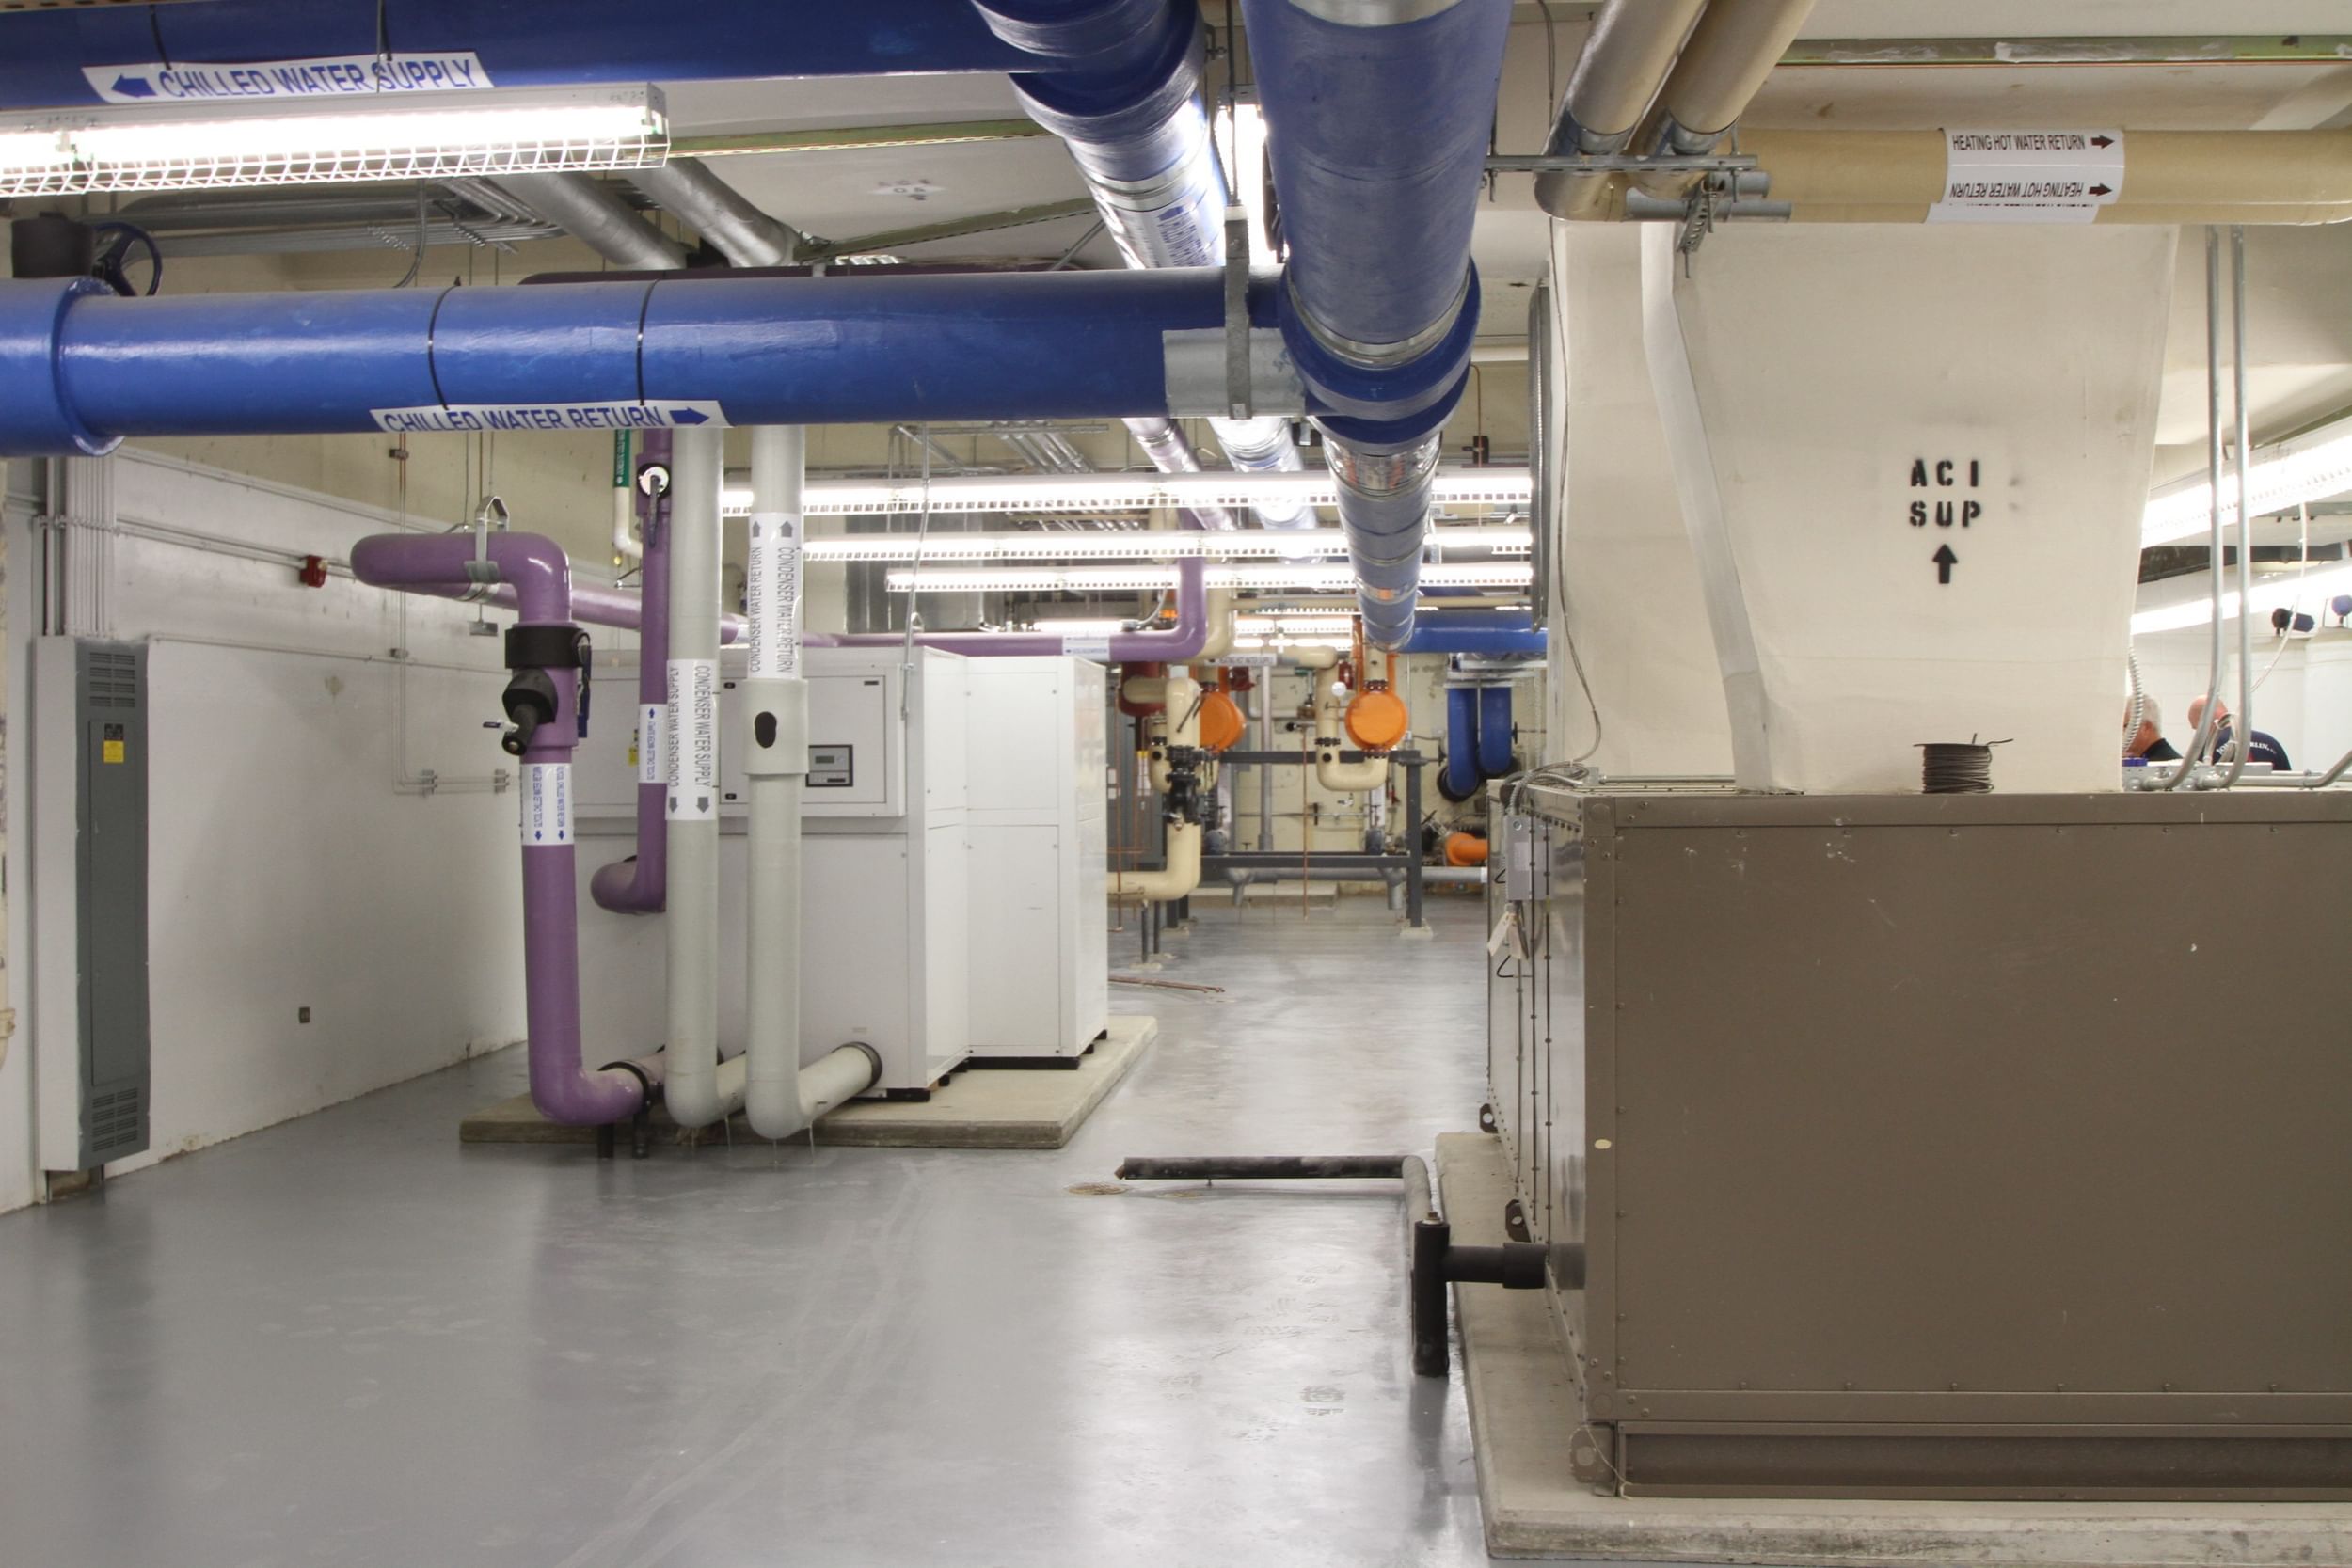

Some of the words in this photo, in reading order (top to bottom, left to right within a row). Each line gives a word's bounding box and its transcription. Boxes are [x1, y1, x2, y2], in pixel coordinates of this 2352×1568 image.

[158, 70, 275, 100] CHILLED
[277, 64, 368, 94] WATER
[372, 58, 478, 91] SUPPLY
[1952, 135, 1993, 151] HEATING
[1994, 135, 2012, 150] HOT
[2013, 135, 2047, 150] WATER
[2047, 135, 2087, 150] RETURN
[1949, 182, 1988, 198] RETURN
[1988, 182, 2022, 198] WATER
[2021, 182, 2042, 198] HOT
[2042, 182, 2085, 198] HEATING
[383, 410, 483, 432] CHILLED
[480, 408, 566, 431] WATER
[568, 404, 667, 429] RETURN
[1909, 500, 1981, 528] SUP
[750, 546, 763, 583] RETURN
[777, 546, 795, 603] CONDENSER
[749, 585, 762, 617] WATER
[777, 603, 794, 636] WATER
[749, 618, 762, 673] CONDENSER
[776, 637, 794, 673] RETURN
[669, 666, 679, 700] SUPPLY
[694, 665, 711, 721] CONDENSER
[668, 701, 679, 732] WATER
[694, 721, 711, 752] WATER
[668, 733, 679, 788] CONDENSER
[694, 752, 711, 788] SUPPLY
